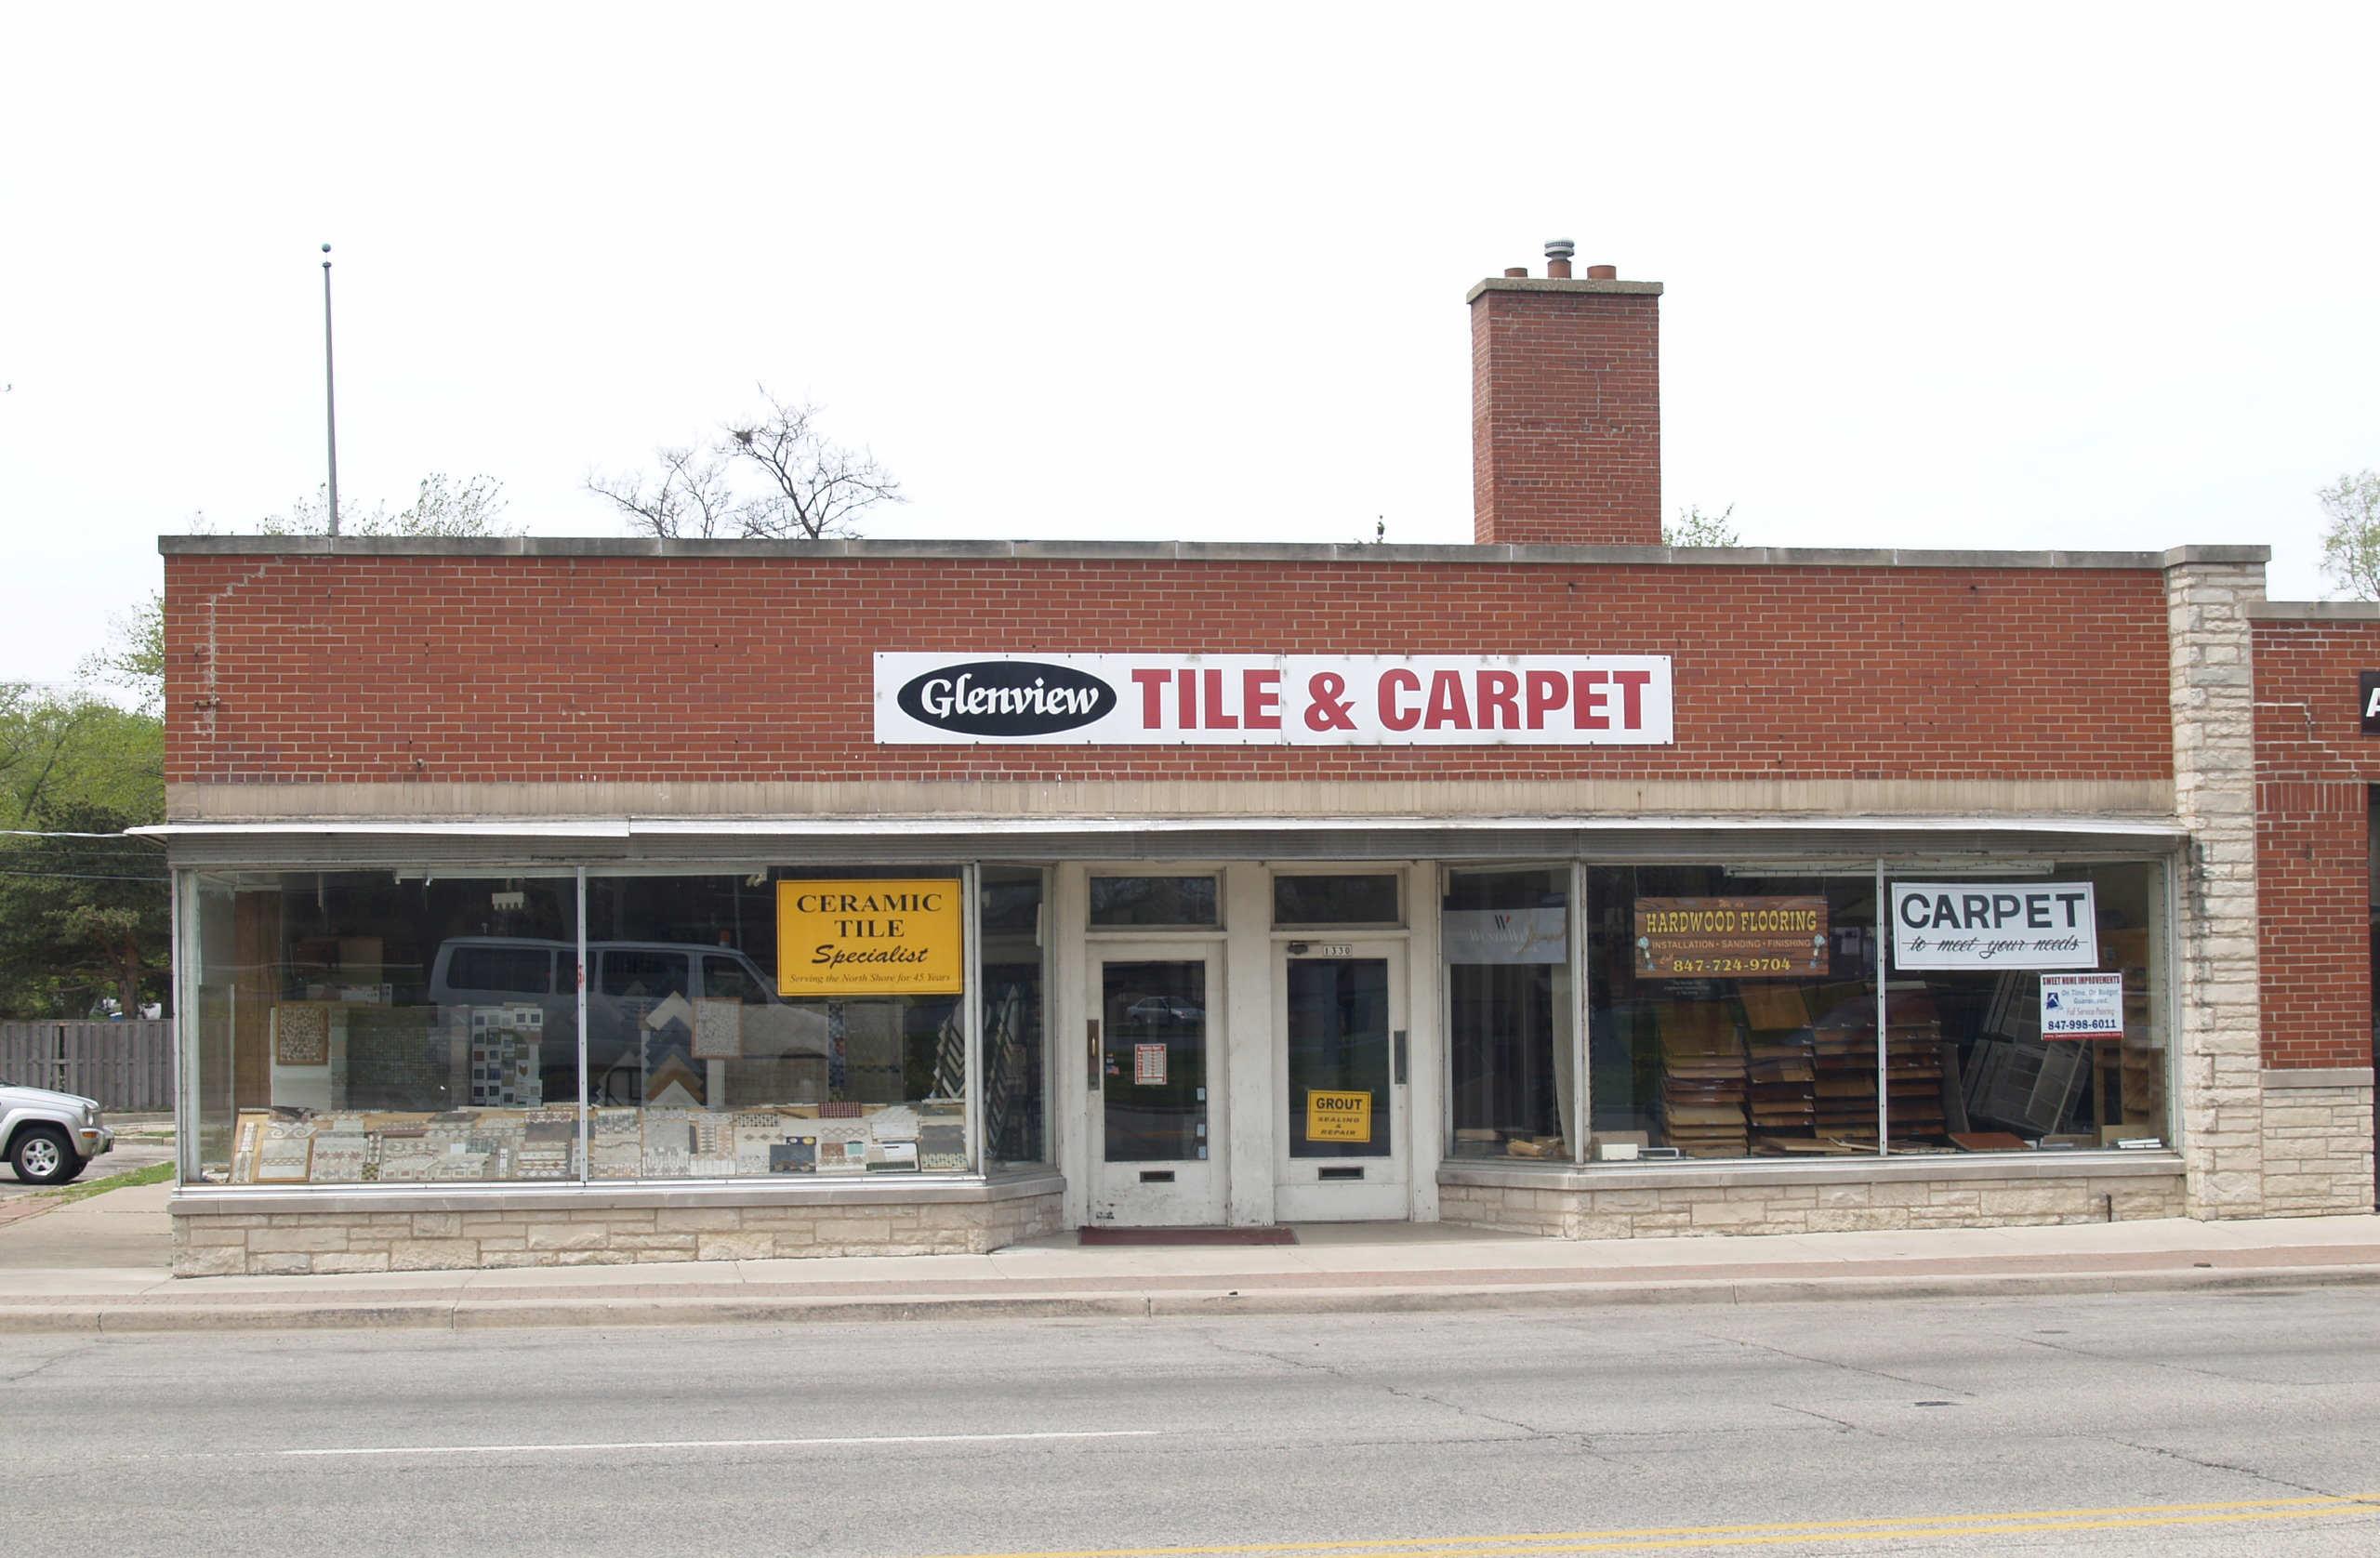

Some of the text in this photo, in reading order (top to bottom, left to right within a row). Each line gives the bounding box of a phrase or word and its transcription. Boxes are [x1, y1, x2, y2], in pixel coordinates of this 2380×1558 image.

[921, 673, 1099, 720] Glenview
[1131, 667, 1651, 733] TILE & CARPET
[796, 893, 943, 913] CERAMIC
[1900, 893, 2085, 929] CARPET
[834, 919, 905, 938] TILE
[1646, 910, 1817, 933] HARDWOOD FLOORING
[1652, 939, 1812, 951] INSTALLATION SANDING FINISHING
[1909, 934, 2080, 959] to meet your needs
[812, 944, 929, 969] Specialist
[1673, 957, 1792, 972] 847-724-9704
[789, 972, 950, 984] Serving the North Shore for 45 Years
[2047, 1019, 2117, 1031] 847-998-6011
[1316, 1097, 1363, 1111] GROUT
